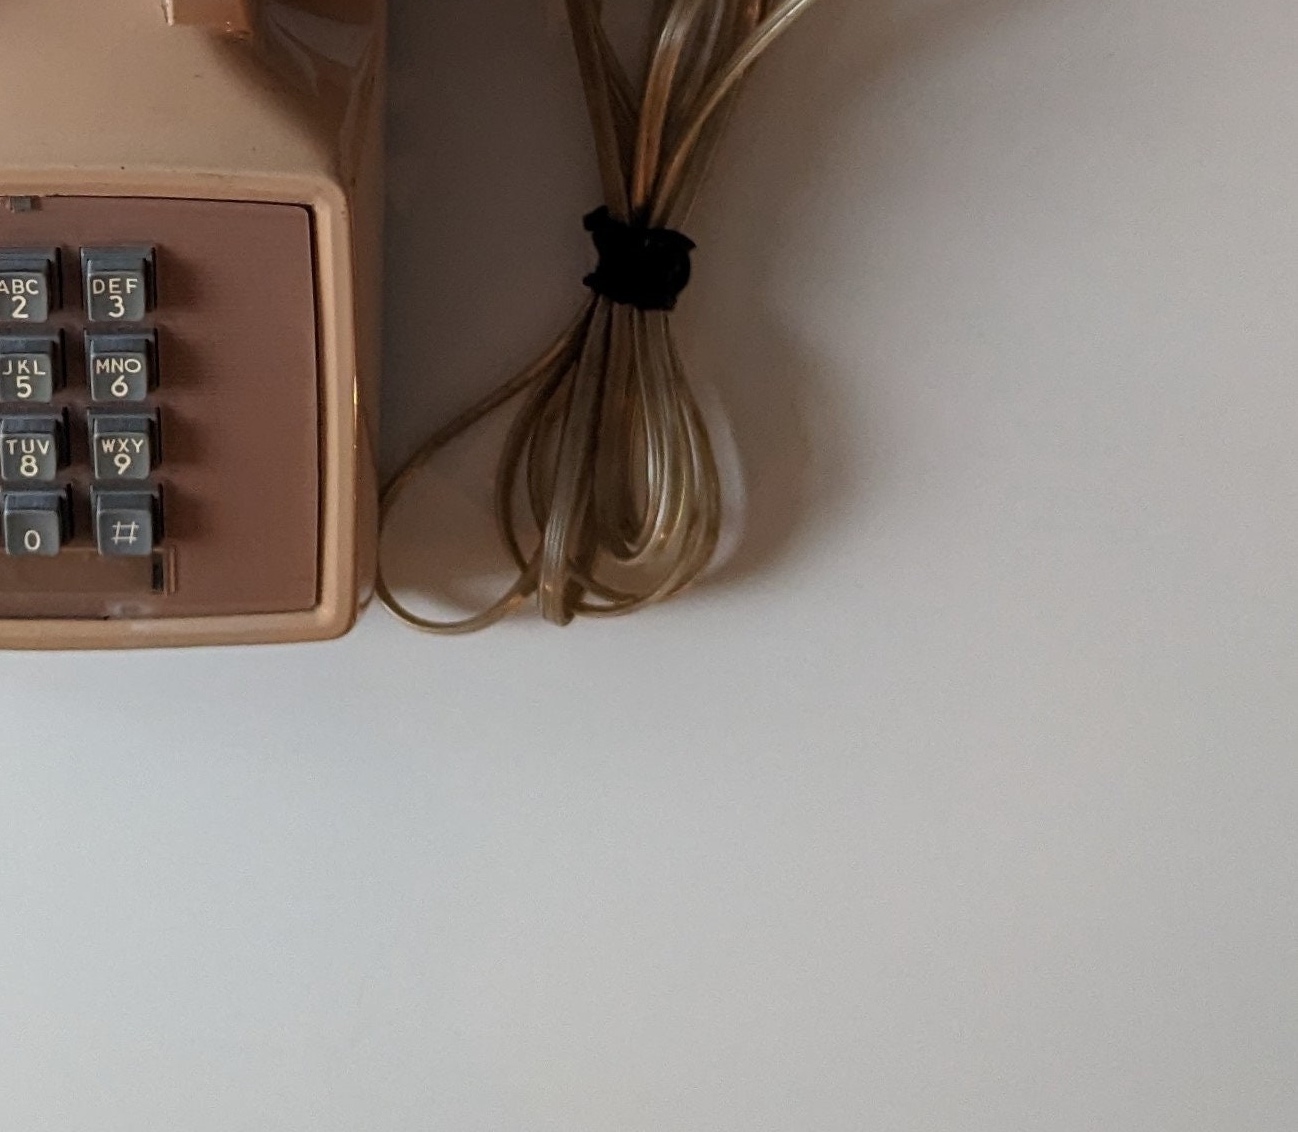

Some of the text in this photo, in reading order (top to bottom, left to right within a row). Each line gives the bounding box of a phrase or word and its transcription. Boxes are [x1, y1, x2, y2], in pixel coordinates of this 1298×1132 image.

[92, 278, 138, 295] DEF
[11, 296, 30, 318] 2
[108, 295, 125, 318] 3
[2, 360, 46, 376] JKL
[96, 358, 142, 374] MNO
[16, 376, 32, 398] 5
[110, 375, 128, 398] 6
[6, 439, 50, 454] TUV
[102, 438, 144, 453] WXY
[20, 454, 38, 477] 8
[114, 454, 132, 475] 9
[24, 529, 40, 551] 0
